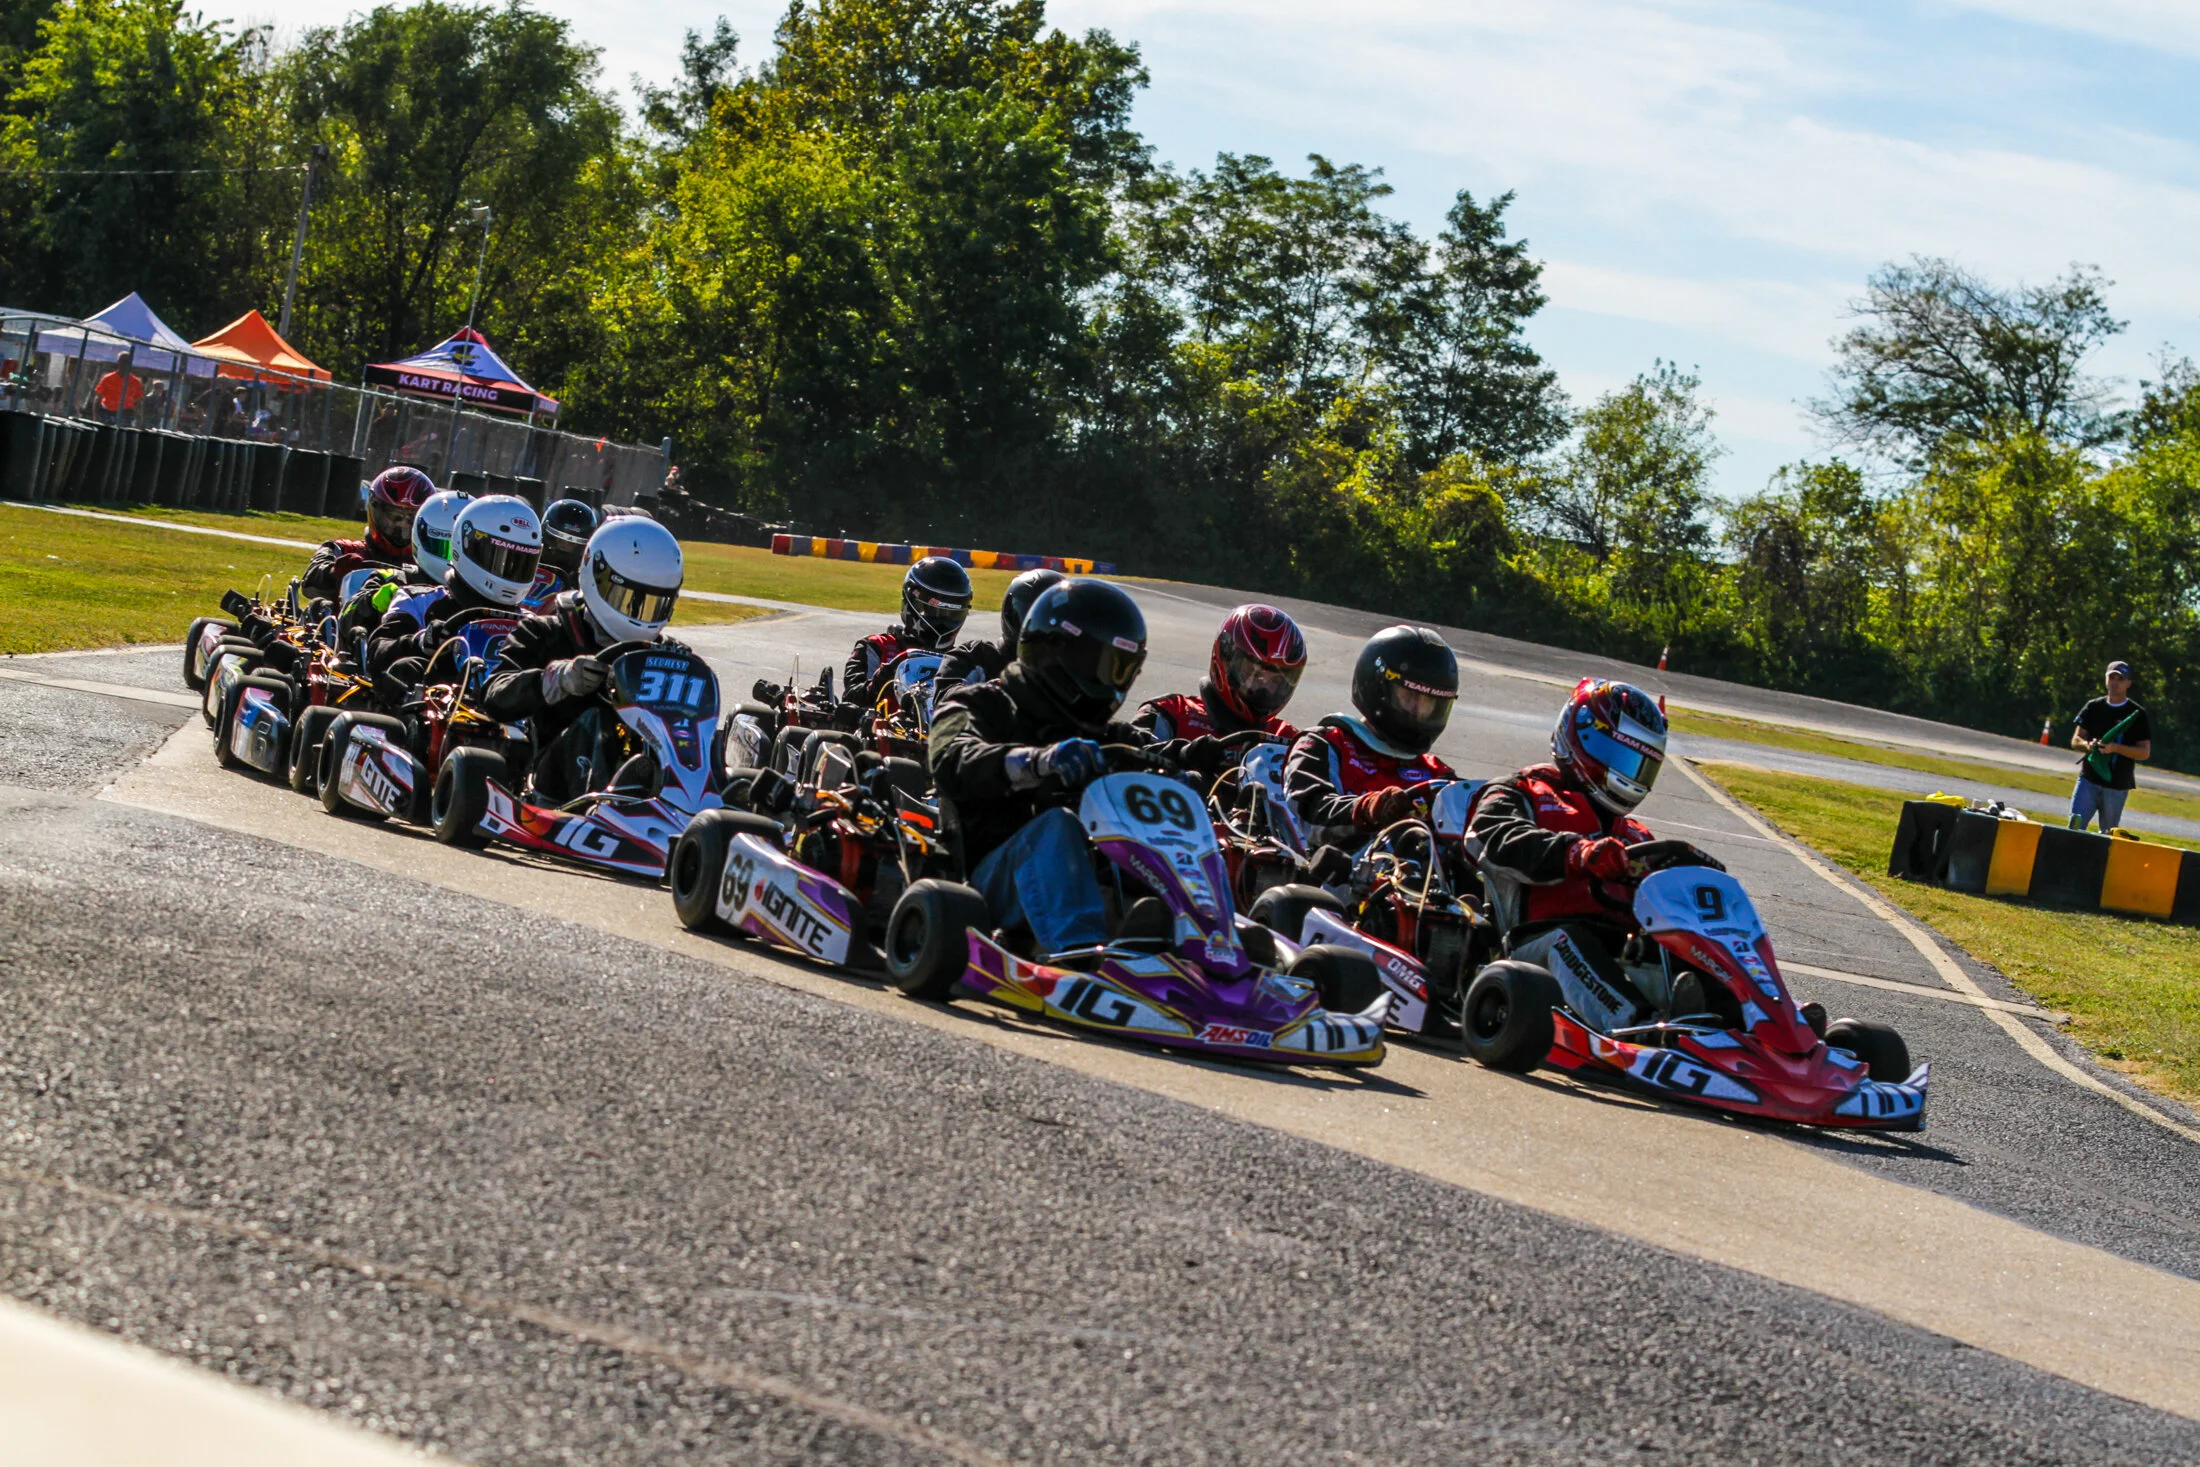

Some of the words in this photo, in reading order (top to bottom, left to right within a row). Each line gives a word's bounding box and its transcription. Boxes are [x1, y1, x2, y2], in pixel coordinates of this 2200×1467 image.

[399, 374, 440, 391] KART
[442, 382, 499, 400] RACING
[513, 518, 530, 528] BELL
[490, 538, 515, 550] TEAM
[646, 657, 689, 671] SECREST
[637, 670, 706, 707] 311
[1403, 680, 1430, 694] TEAM
[1611, 731, 1639, 750] TEAM
[1123, 784, 1197, 831] 69
[555, 817, 621, 858] IG
[722, 853, 754, 912] 69
[761, 878, 832, 955] IGNITE
[1695, 886, 1726, 921] 9
[1387, 957, 1426, 989] OMG
[1553, 932, 1624, 1016] BRIDGESTONE
[1059, 977, 1138, 1027] IG
[1204, 1025, 1273, 1048] AMSOIL
[1642, 1051, 1712, 1095] IG
